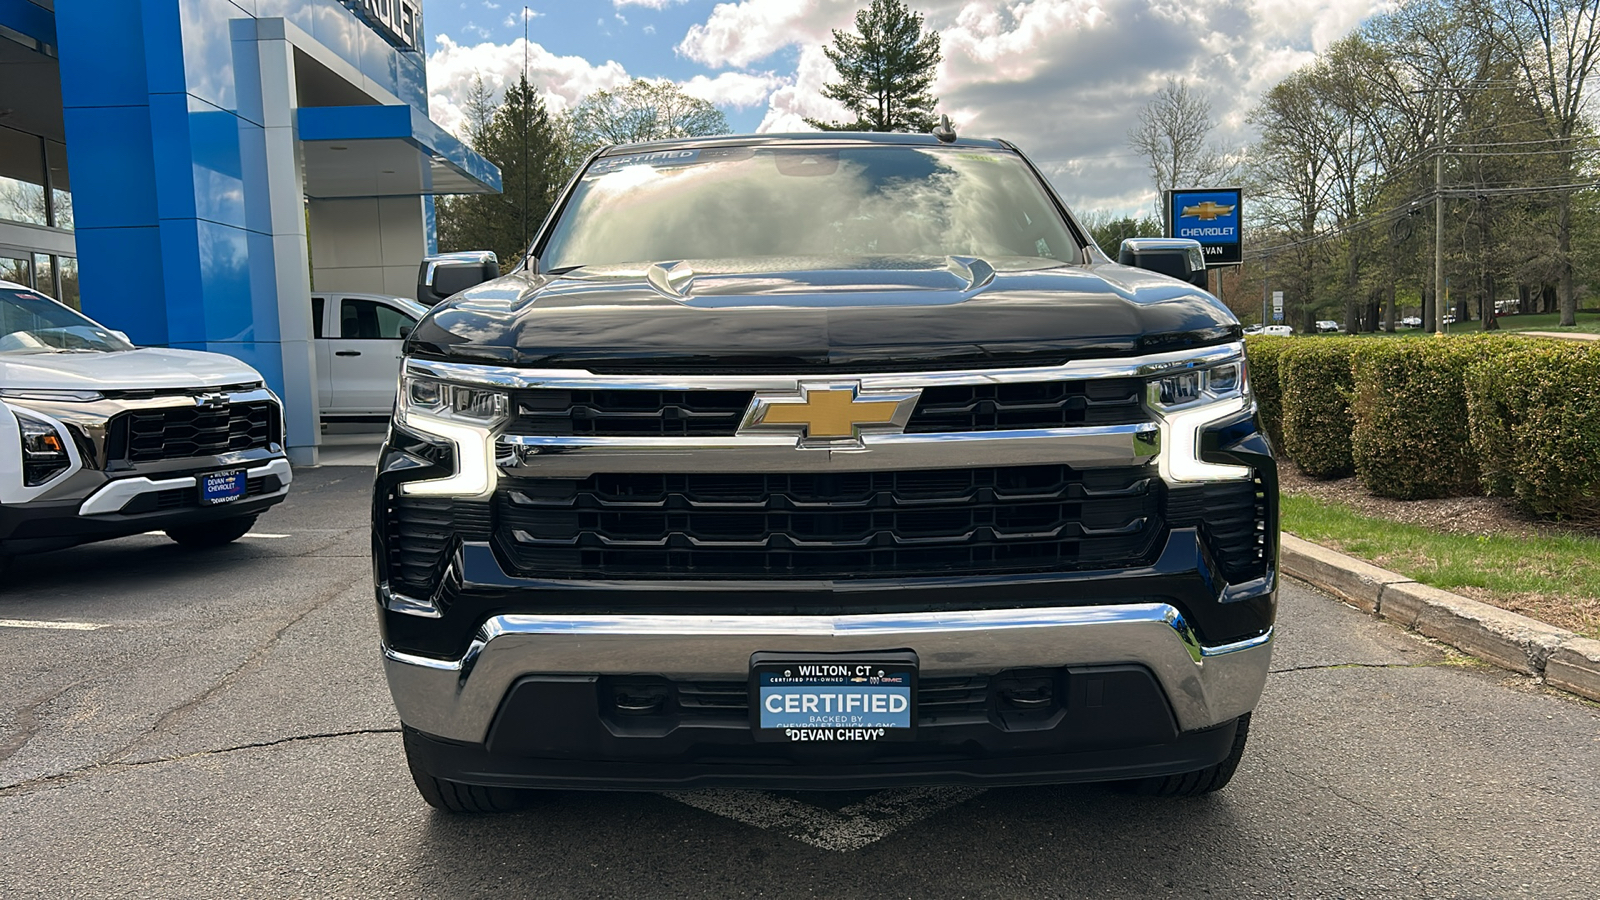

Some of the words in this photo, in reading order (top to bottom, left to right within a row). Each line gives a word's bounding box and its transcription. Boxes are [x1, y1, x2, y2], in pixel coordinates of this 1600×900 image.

[594, 152, 693, 169] CERTIFIED
[1181, 227, 1235, 237] CHEVROLET
[1201, 246, 1223, 255] EVAN
[208, 478, 225, 486] DEVAN
[208, 483, 235, 492] CHEVROLET
[799, 665, 851, 677] WILTON,
[855, 665, 872, 676] CT
[765, 694, 908, 713] CERTIFIED
[809, 715, 848, 723] BACKED
[851, 715, 864, 723] BY
[791, 729, 834, 741] DEVAN
[836, 728, 879, 741] CHEVY
